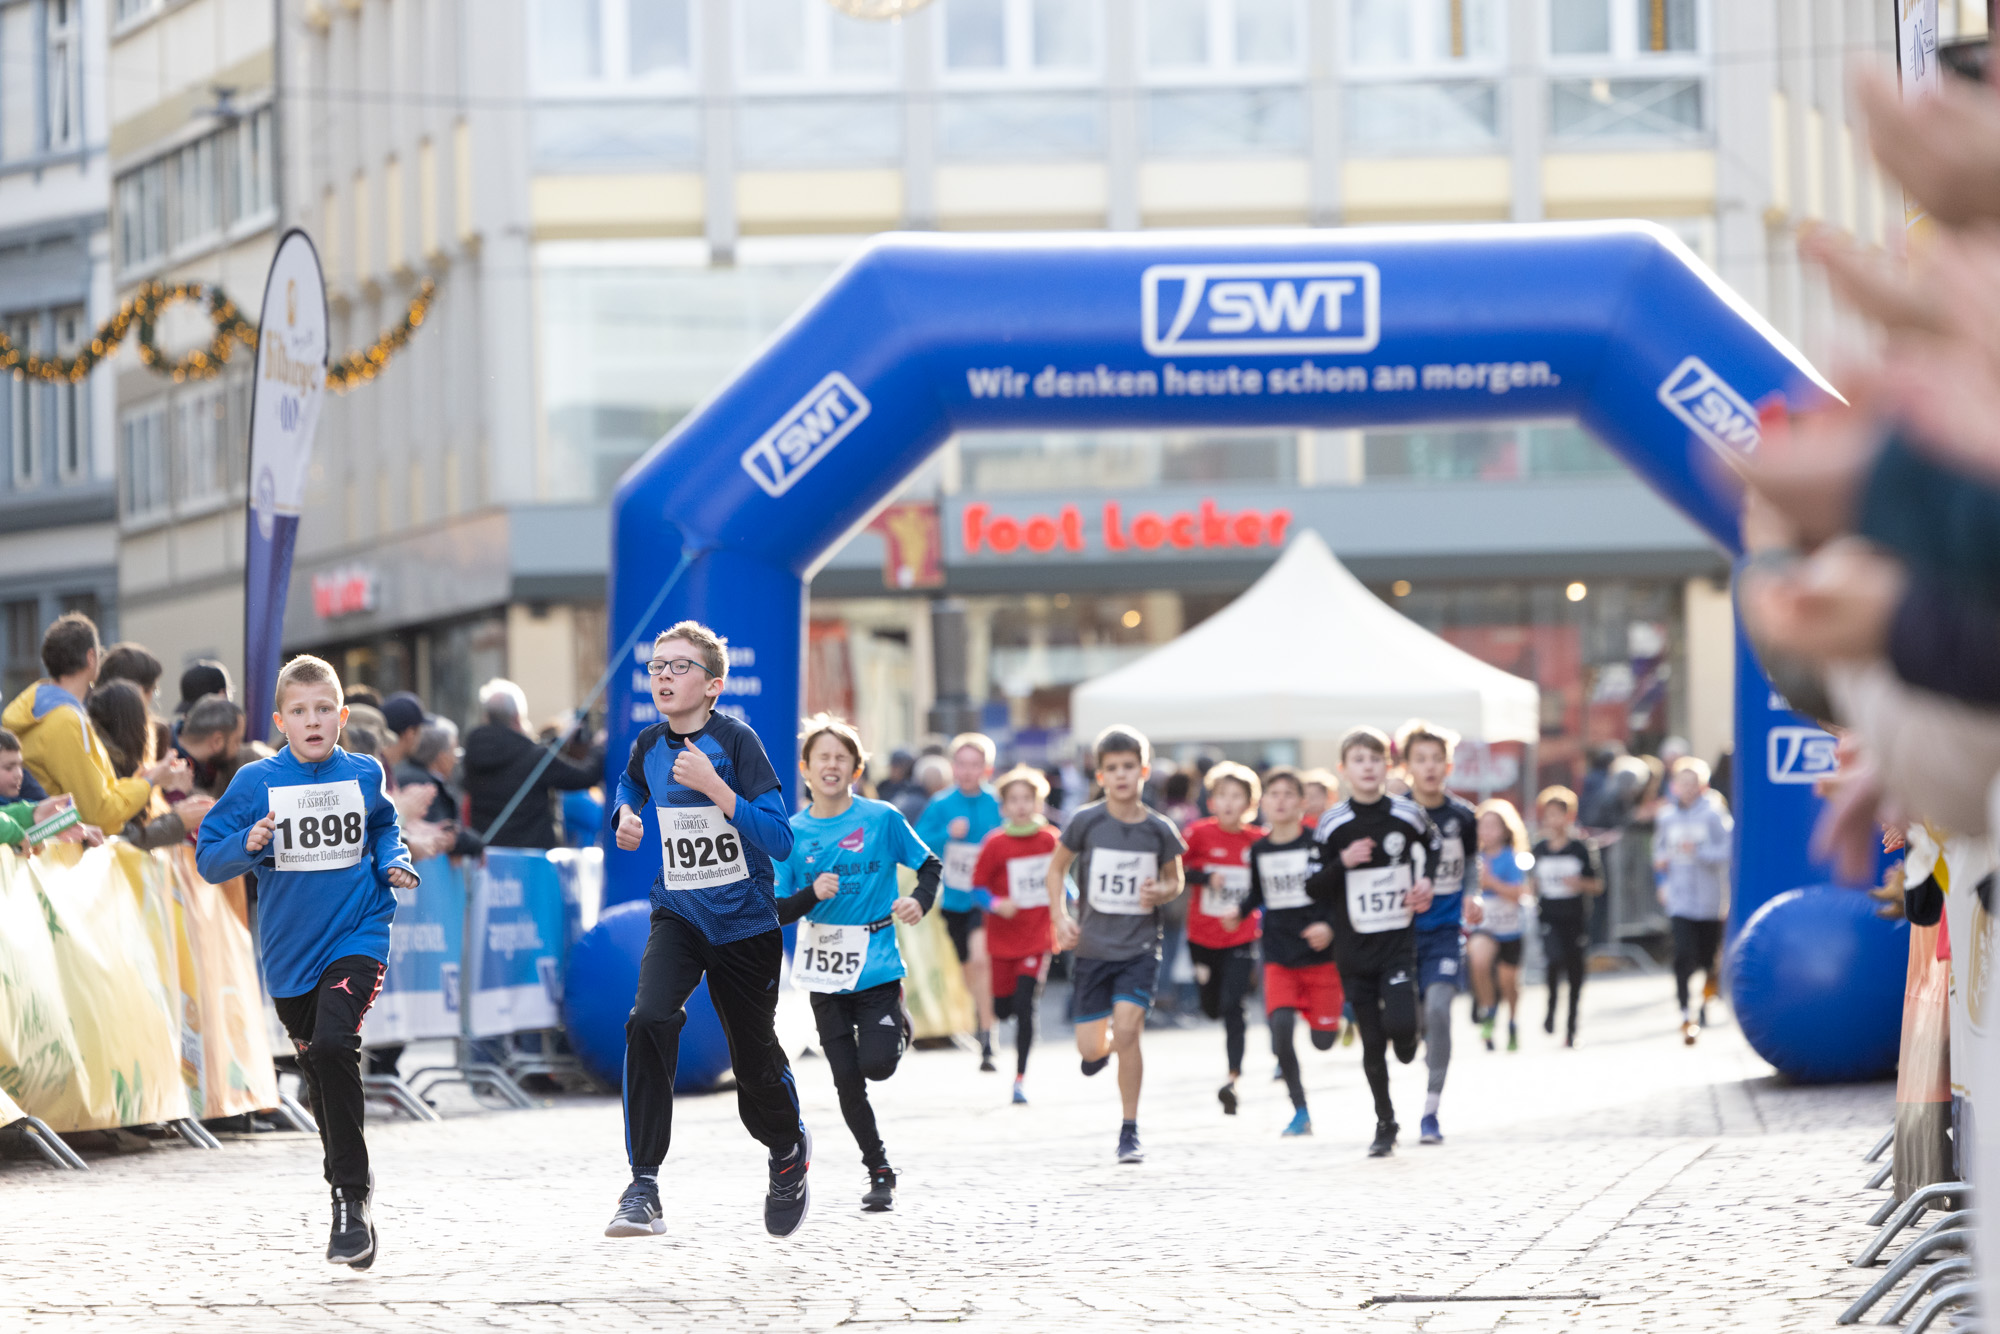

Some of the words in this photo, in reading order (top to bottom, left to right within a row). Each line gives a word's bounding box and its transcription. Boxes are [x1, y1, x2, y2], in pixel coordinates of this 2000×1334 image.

[1208, 280, 1355, 333] SWT
[966, 366, 1030, 399] Wir
[1033, 364, 1159, 398] denken
[1163, 362, 1263, 397] heute
[1267, 359, 1368, 394] schon
[1372, 364, 1416, 392] an
[1421, 360, 1561, 395] morgen.
[776, 388, 849, 465] SWT
[963, 501, 1084, 554] Foot
[1103, 499, 1293, 550] Locker
[297, 795, 340, 809] FASSBRAUSE
[276, 812, 361, 849] 1898
[673, 819, 710, 831] FASSBRAUSE
[280, 851, 320, 864] Trierischer
[321, 847, 360, 861] Volksfreund
[664, 833, 739, 869] 1926
[667, 870, 698, 882] Trierischer
[698, 863, 741, 881] Volksfreund
[1098, 874, 1137, 895] 151
[804, 948, 860, 975] 1525
